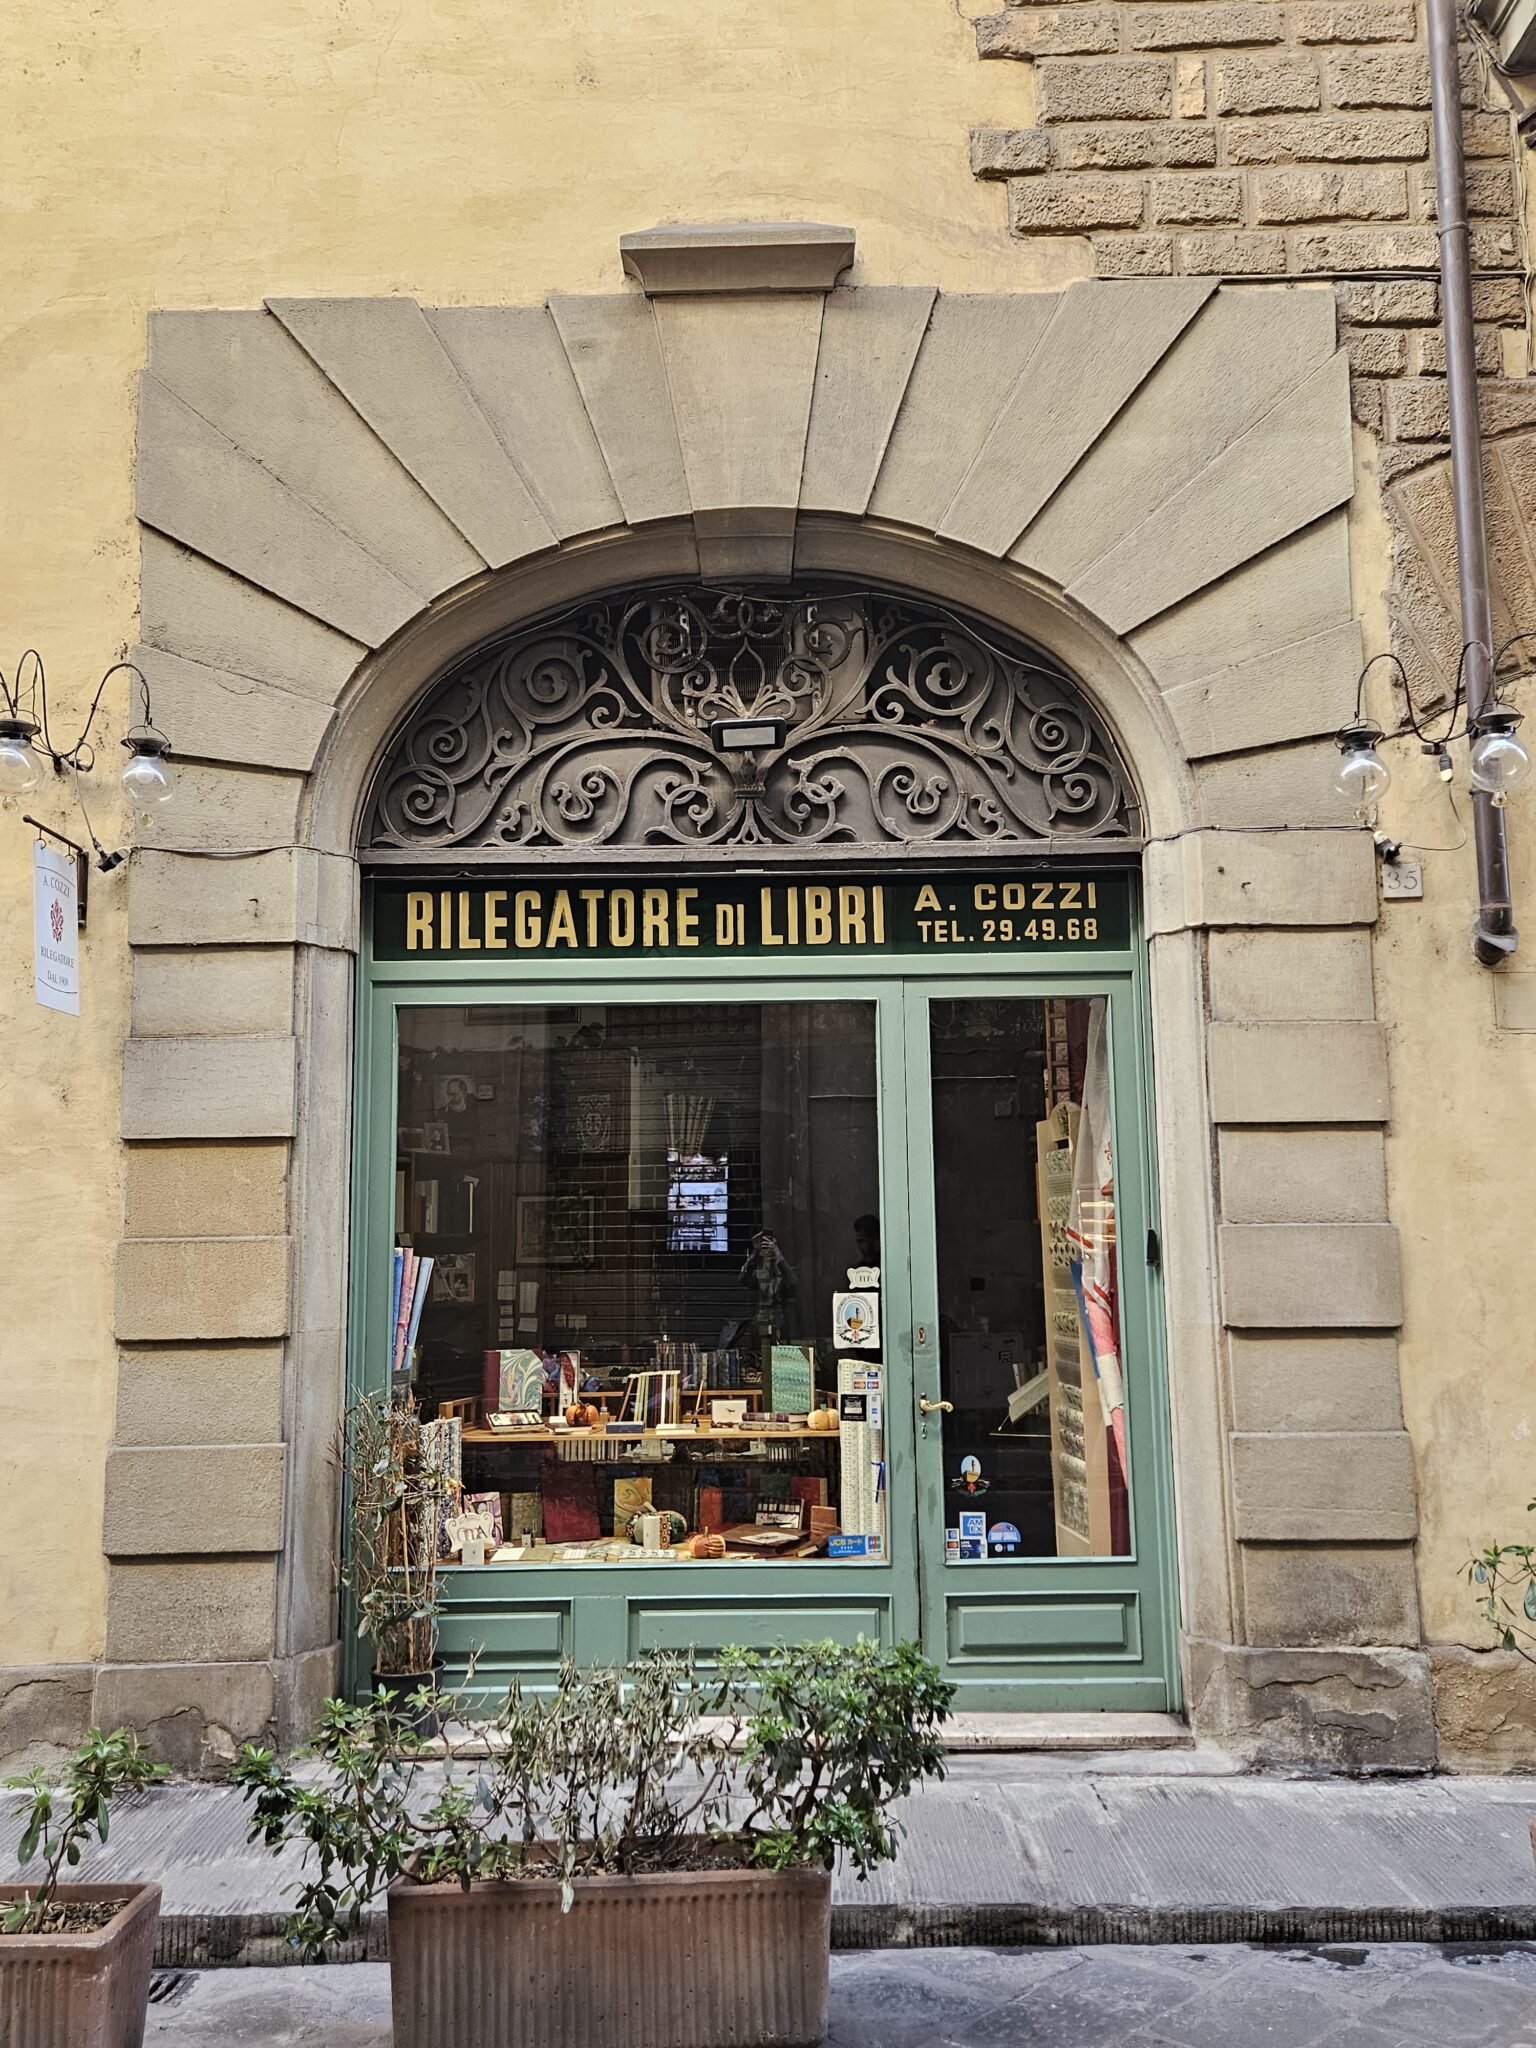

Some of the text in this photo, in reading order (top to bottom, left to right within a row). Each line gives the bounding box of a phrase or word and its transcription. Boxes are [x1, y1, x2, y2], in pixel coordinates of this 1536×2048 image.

[51, 876, 70, 898] COZZI
[1388, 870, 1418, 890] 35
[915, 882, 1098, 912] A. COZZI
[406, 885, 886, 951] RILEGATORE DI LIBRI
[917, 917, 1098, 943] TEL. 29.49.68
[40, 945, 75, 969] RILEGATORE
[47, 969, 59, 984] DAL
